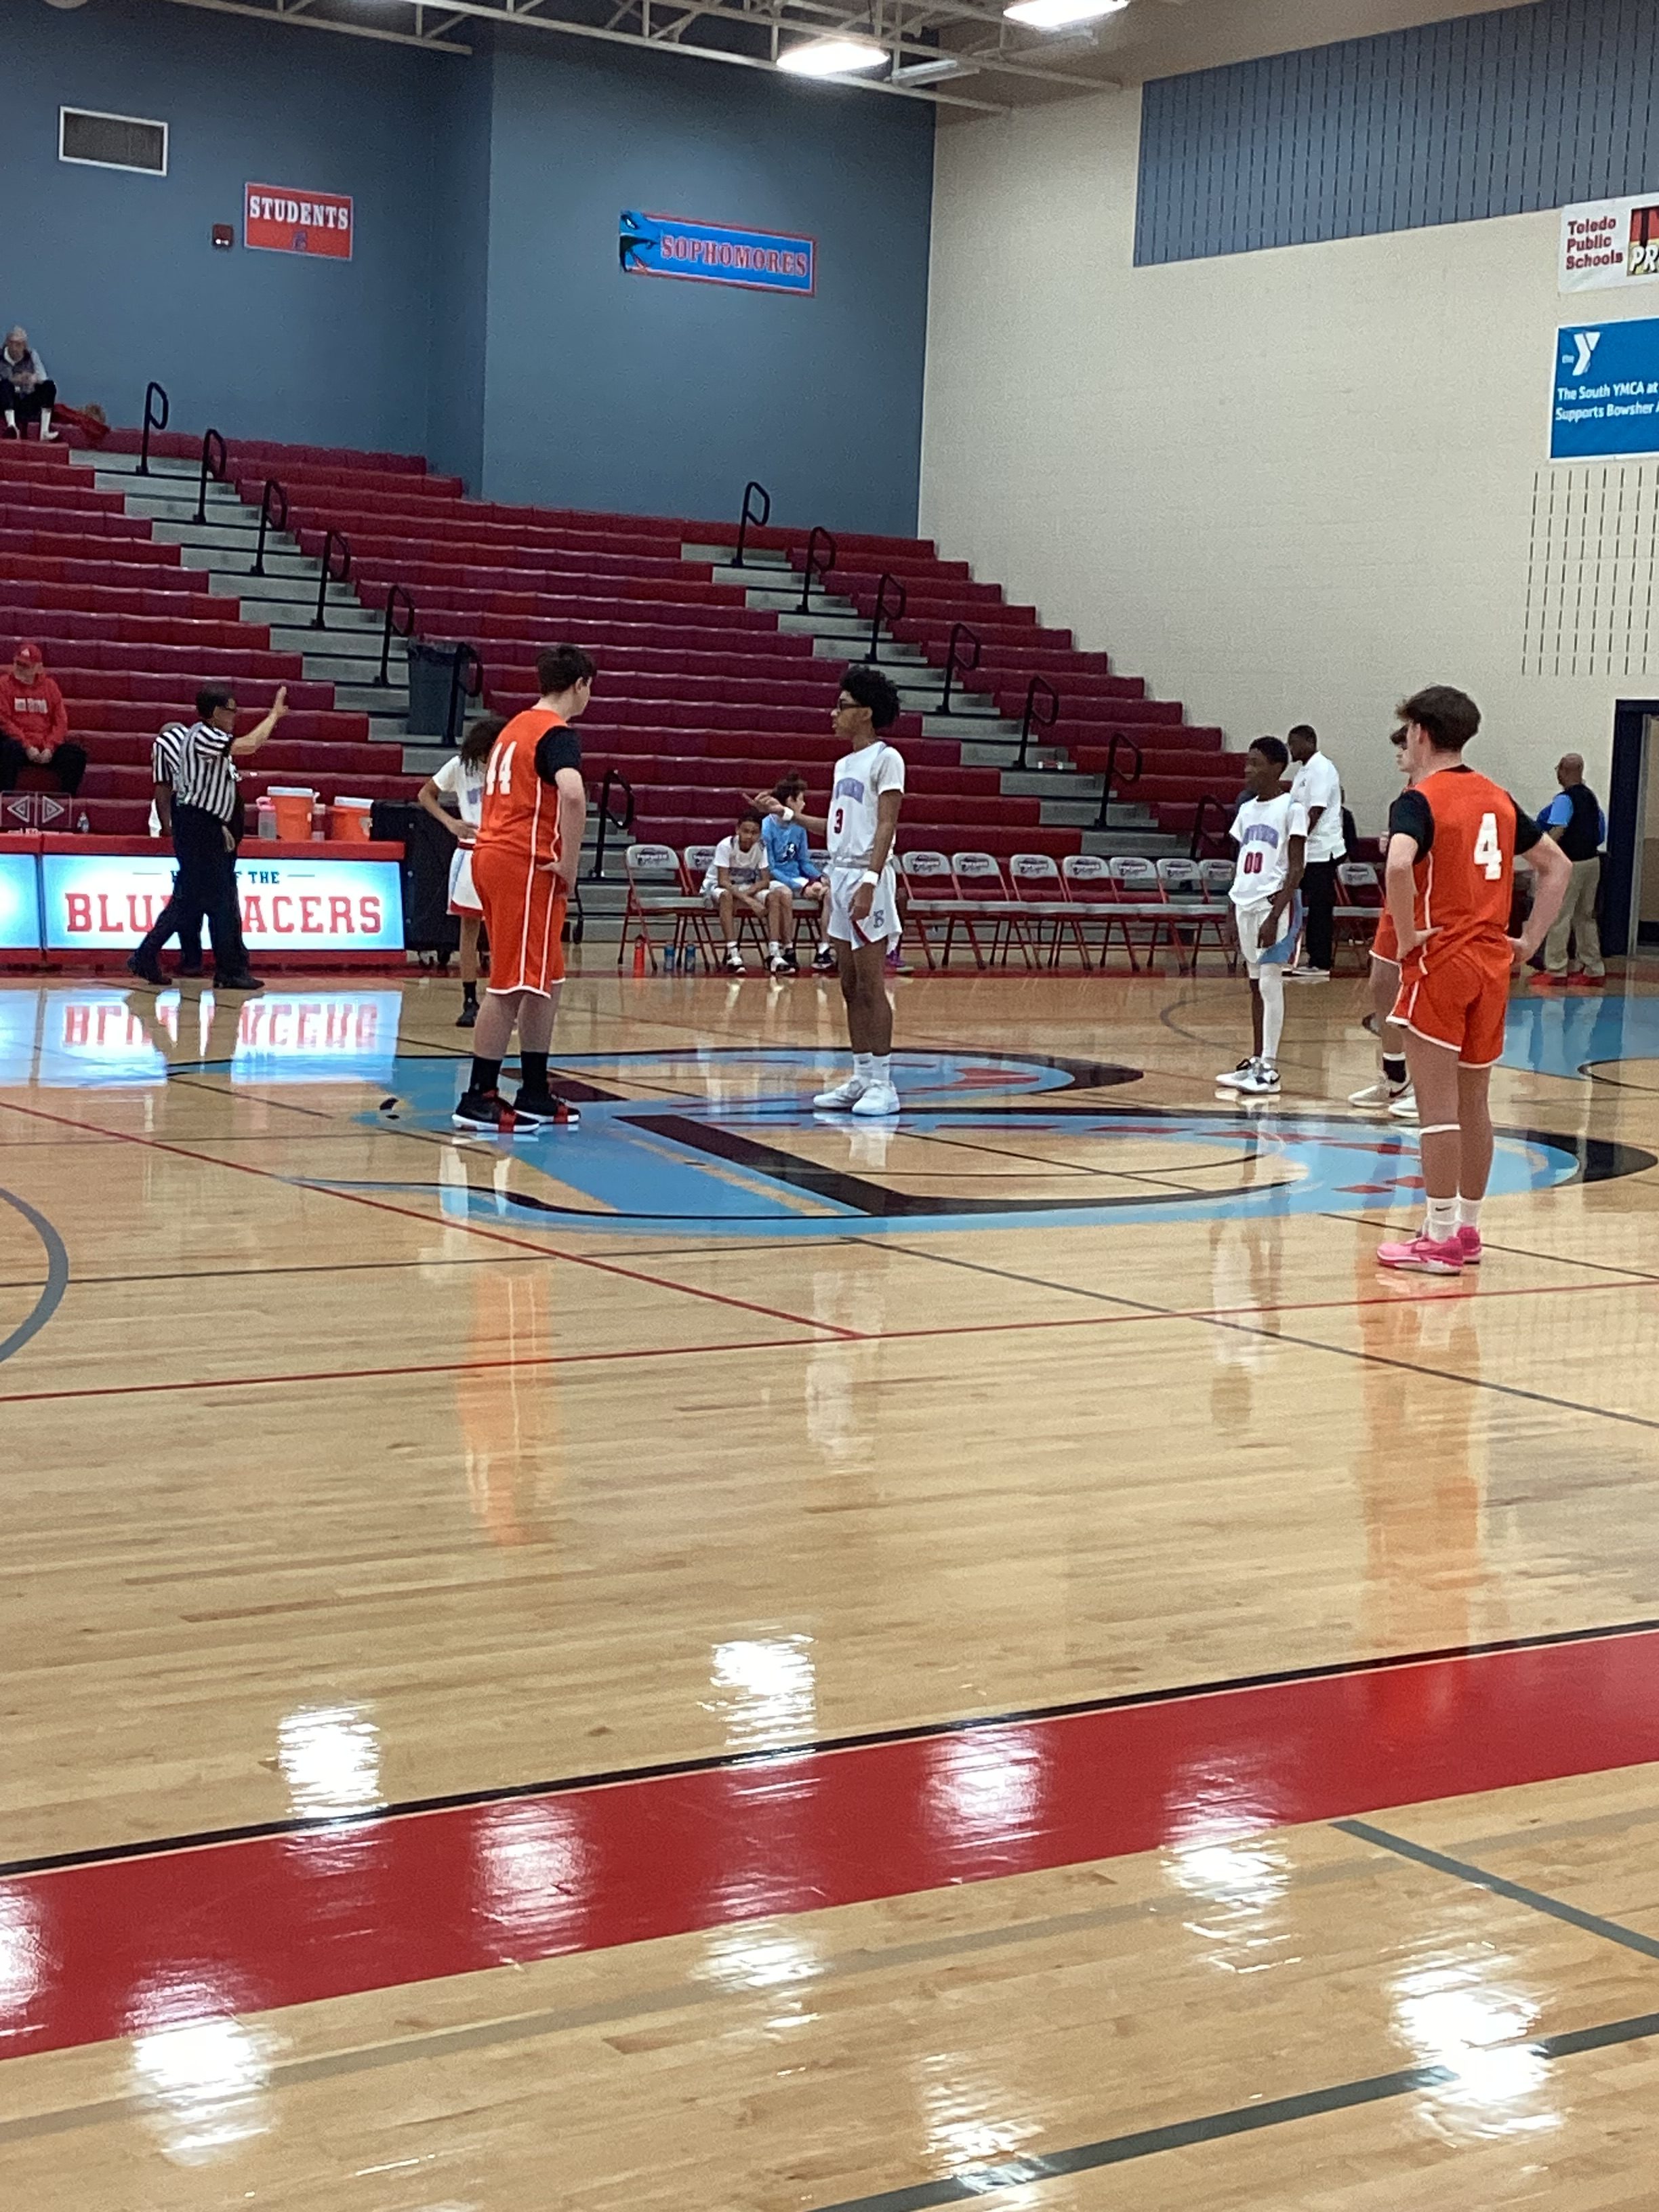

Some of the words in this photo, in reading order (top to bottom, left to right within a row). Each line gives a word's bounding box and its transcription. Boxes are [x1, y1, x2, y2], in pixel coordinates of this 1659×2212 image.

[249, 195, 349, 230] STUDENTS
[1567, 216, 1616, 235] Toledo
[660, 234, 808, 276] SOPHOMORES
[1567, 234, 1612, 253] Public
[1566, 249, 1623, 270] Schools
[1557, 387, 1577, 401] The
[1578, 383, 1610, 400] South
[1613, 381, 1645, 396] YMCA
[1555, 405, 1604, 423] Supports
[1606, 400, 1654, 417] Bowsher
[486, 741, 517, 796] 44
[834, 808, 844, 834] 3
[1473, 813, 1502, 880] 4
[1244, 851, 1263, 874] 00
[247, 871, 280, 884] THE
[65, 893, 173, 933] BLU
[242, 895, 381, 934] ACERS
